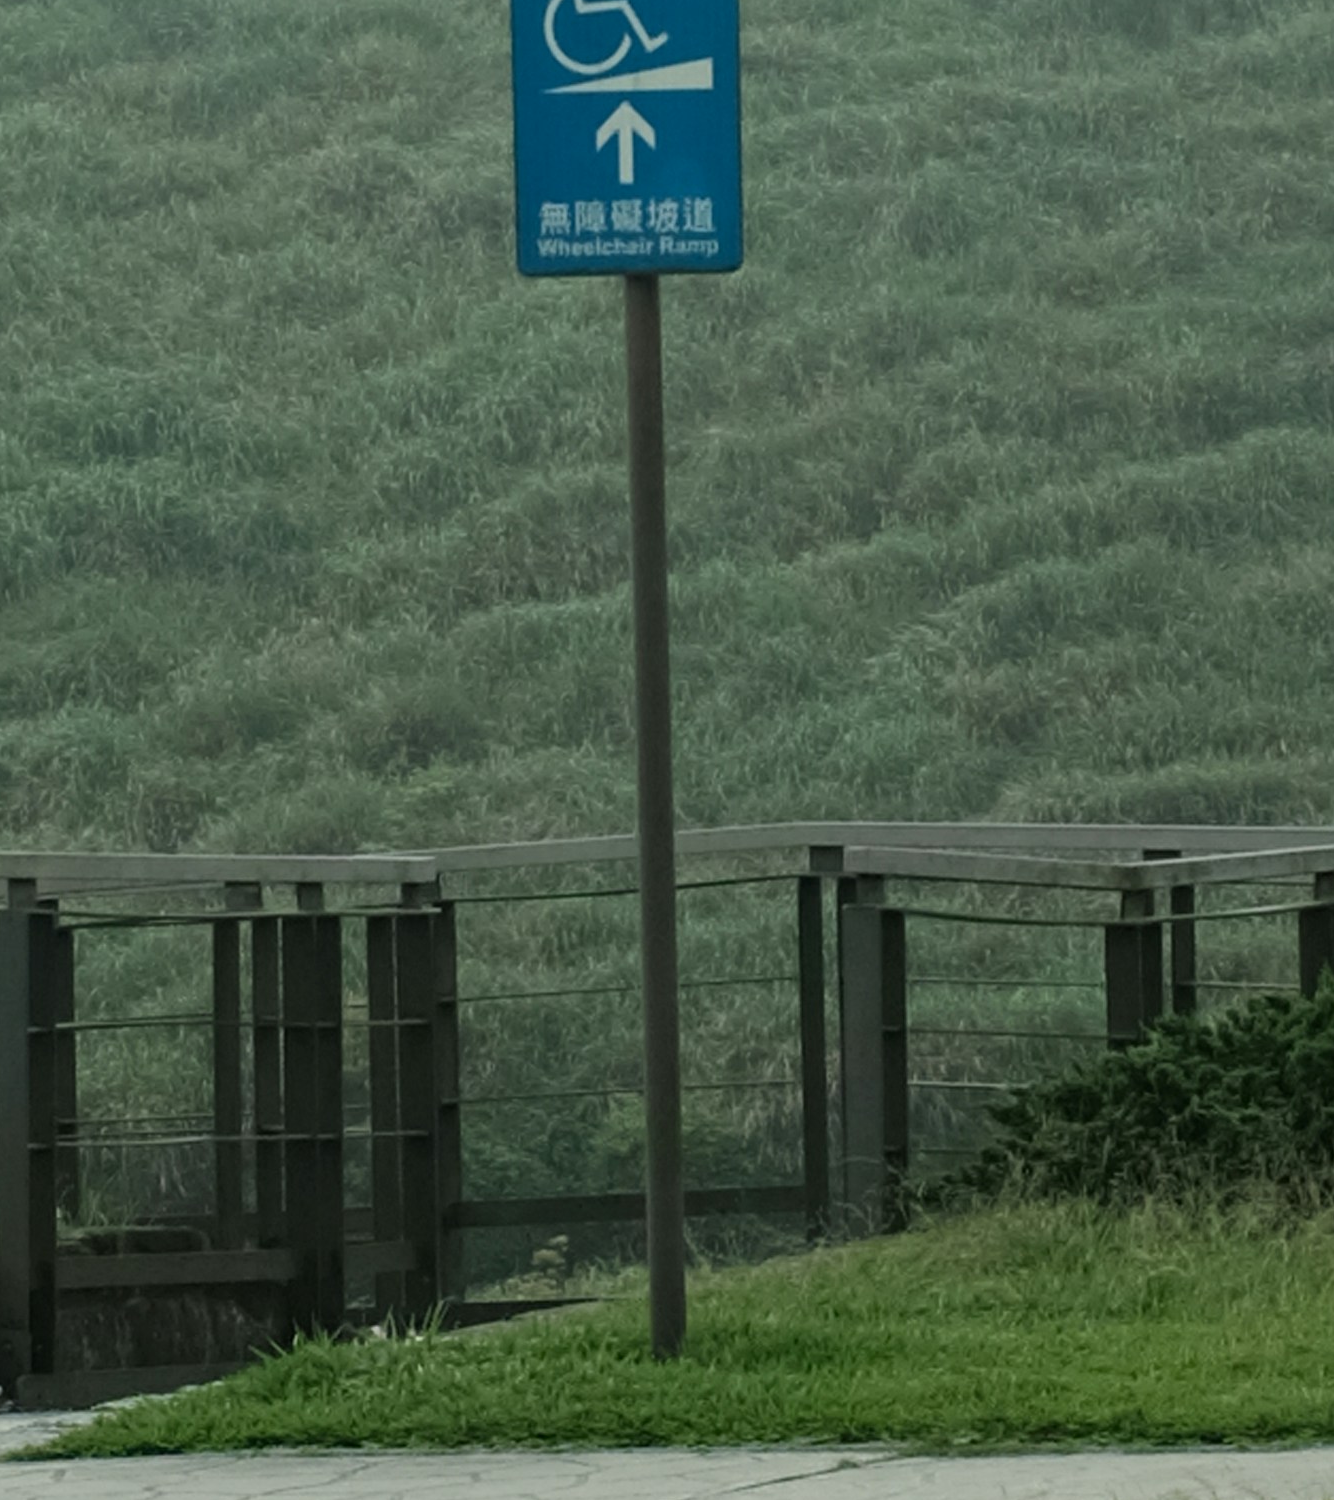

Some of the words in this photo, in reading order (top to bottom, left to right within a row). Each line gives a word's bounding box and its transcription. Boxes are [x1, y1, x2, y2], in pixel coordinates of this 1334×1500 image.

[539, 196, 715, 236] 無障礙坡道
[538, 236, 654, 257] Wheelchair
[660, 236, 718, 258] Ramp
